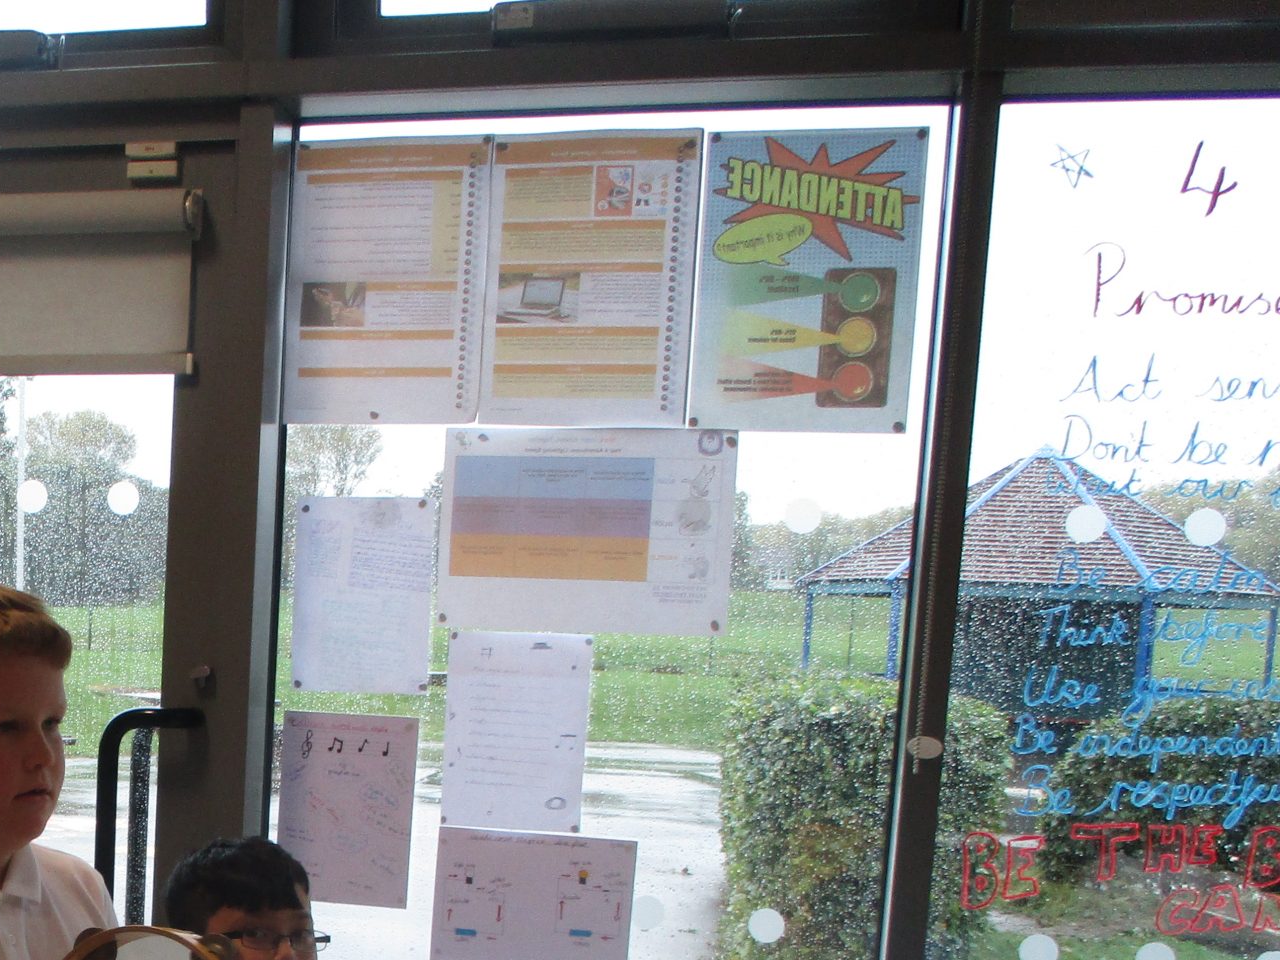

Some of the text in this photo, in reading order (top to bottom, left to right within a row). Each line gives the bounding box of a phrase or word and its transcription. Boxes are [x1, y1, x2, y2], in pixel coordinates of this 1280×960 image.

[1180, 140, 1238, 217] 4
[1084, 242, 1280, 317] Promis
[1059, 352, 1161, 402] Act
[1173, 421, 1227, 466] be
[1051, 549, 1266, 593] Be calm
[1036, 604, 1269, 668] Think before
[1023, 665, 1100, 708] Use
[1121, 676, 1214, 728] your
[1010, 713, 1058, 755] Be
[1013, 764, 1076, 817] Be
[961, 831, 1046, 911] BE
[1070, 822, 1224, 882] THE
